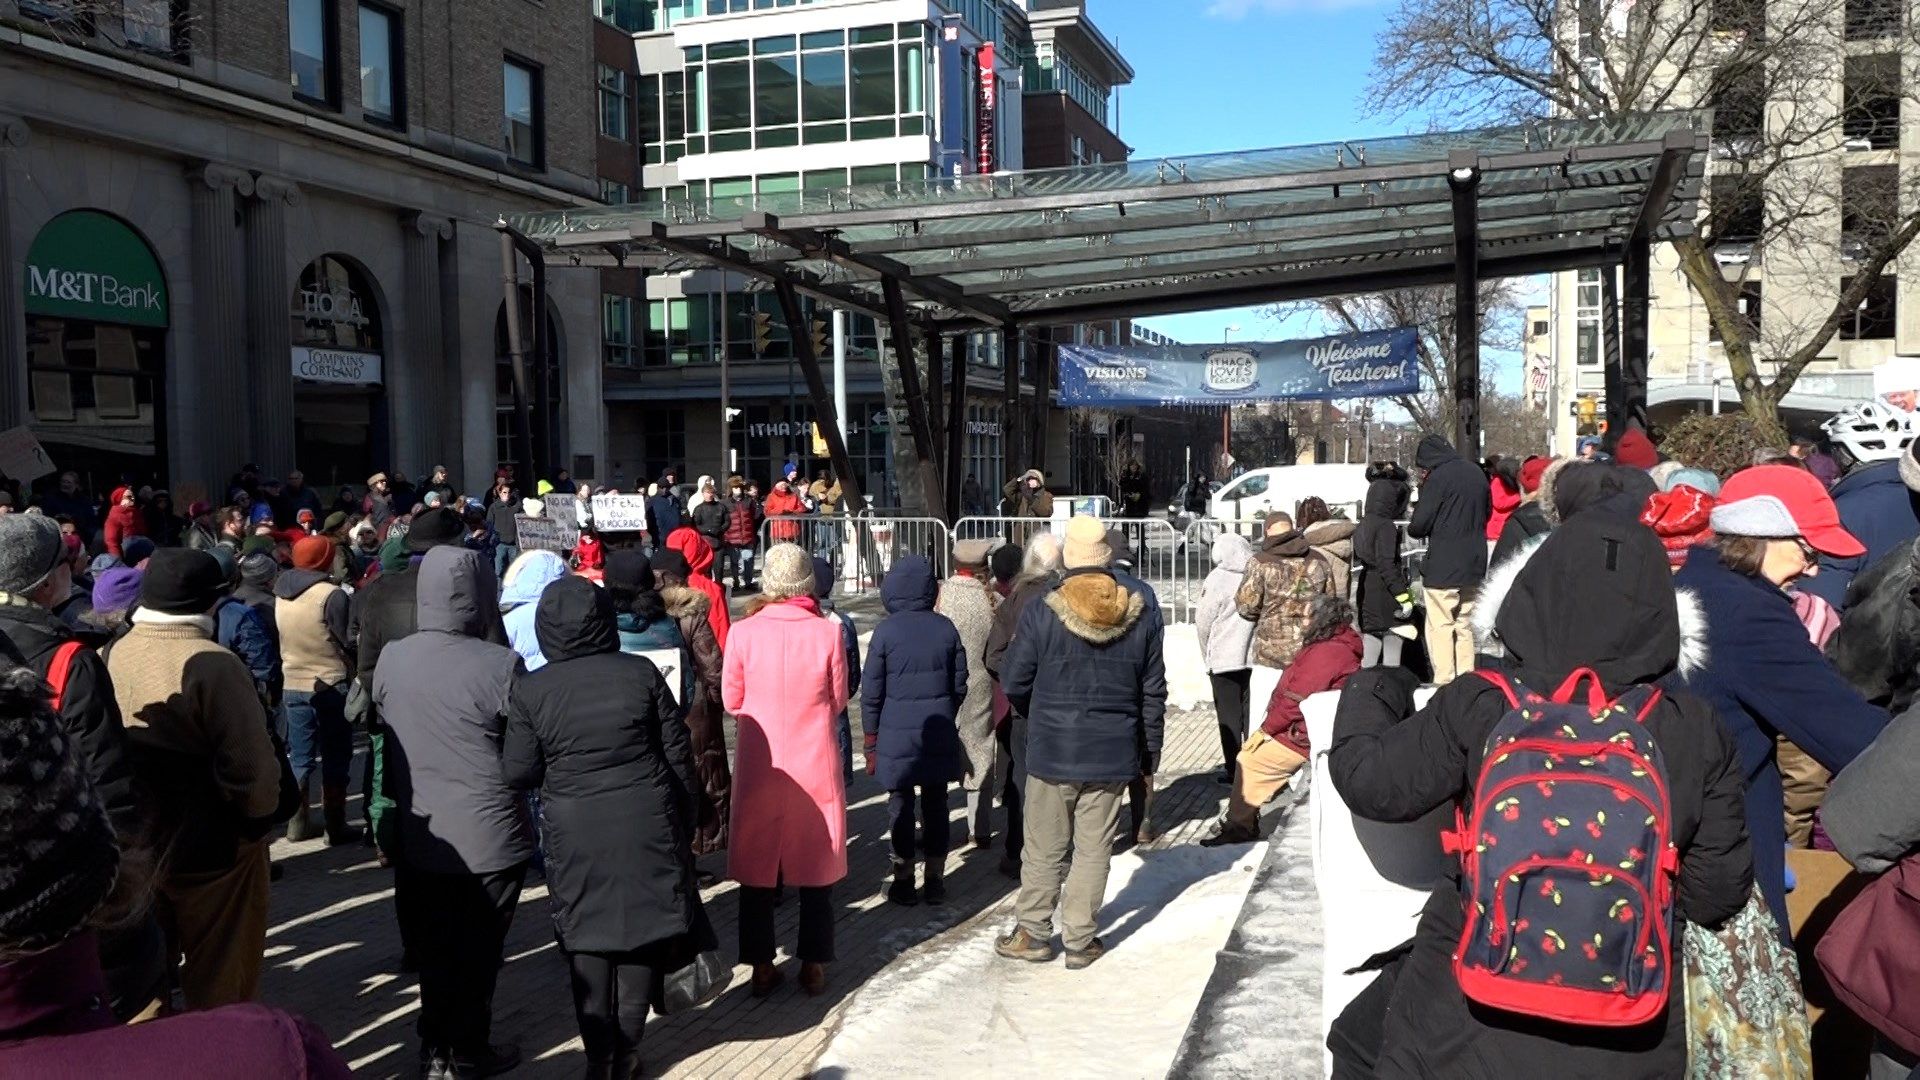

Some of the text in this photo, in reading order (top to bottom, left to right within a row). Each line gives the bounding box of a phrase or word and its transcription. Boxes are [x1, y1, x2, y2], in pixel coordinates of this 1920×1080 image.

[979, 67, 994, 167] UNIVERSITY
[28, 264, 161, 311] M&T Bank
[307, 348, 365, 367] TOMPKINS
[1210, 357, 1252, 367] ITHACA
[1305, 339, 1391, 368] Welcome
[300, 361, 361, 380] CORTLAND
[1084, 366, 1147, 380] VISIONS
[1318, 359, 1408, 388] Teachers!
